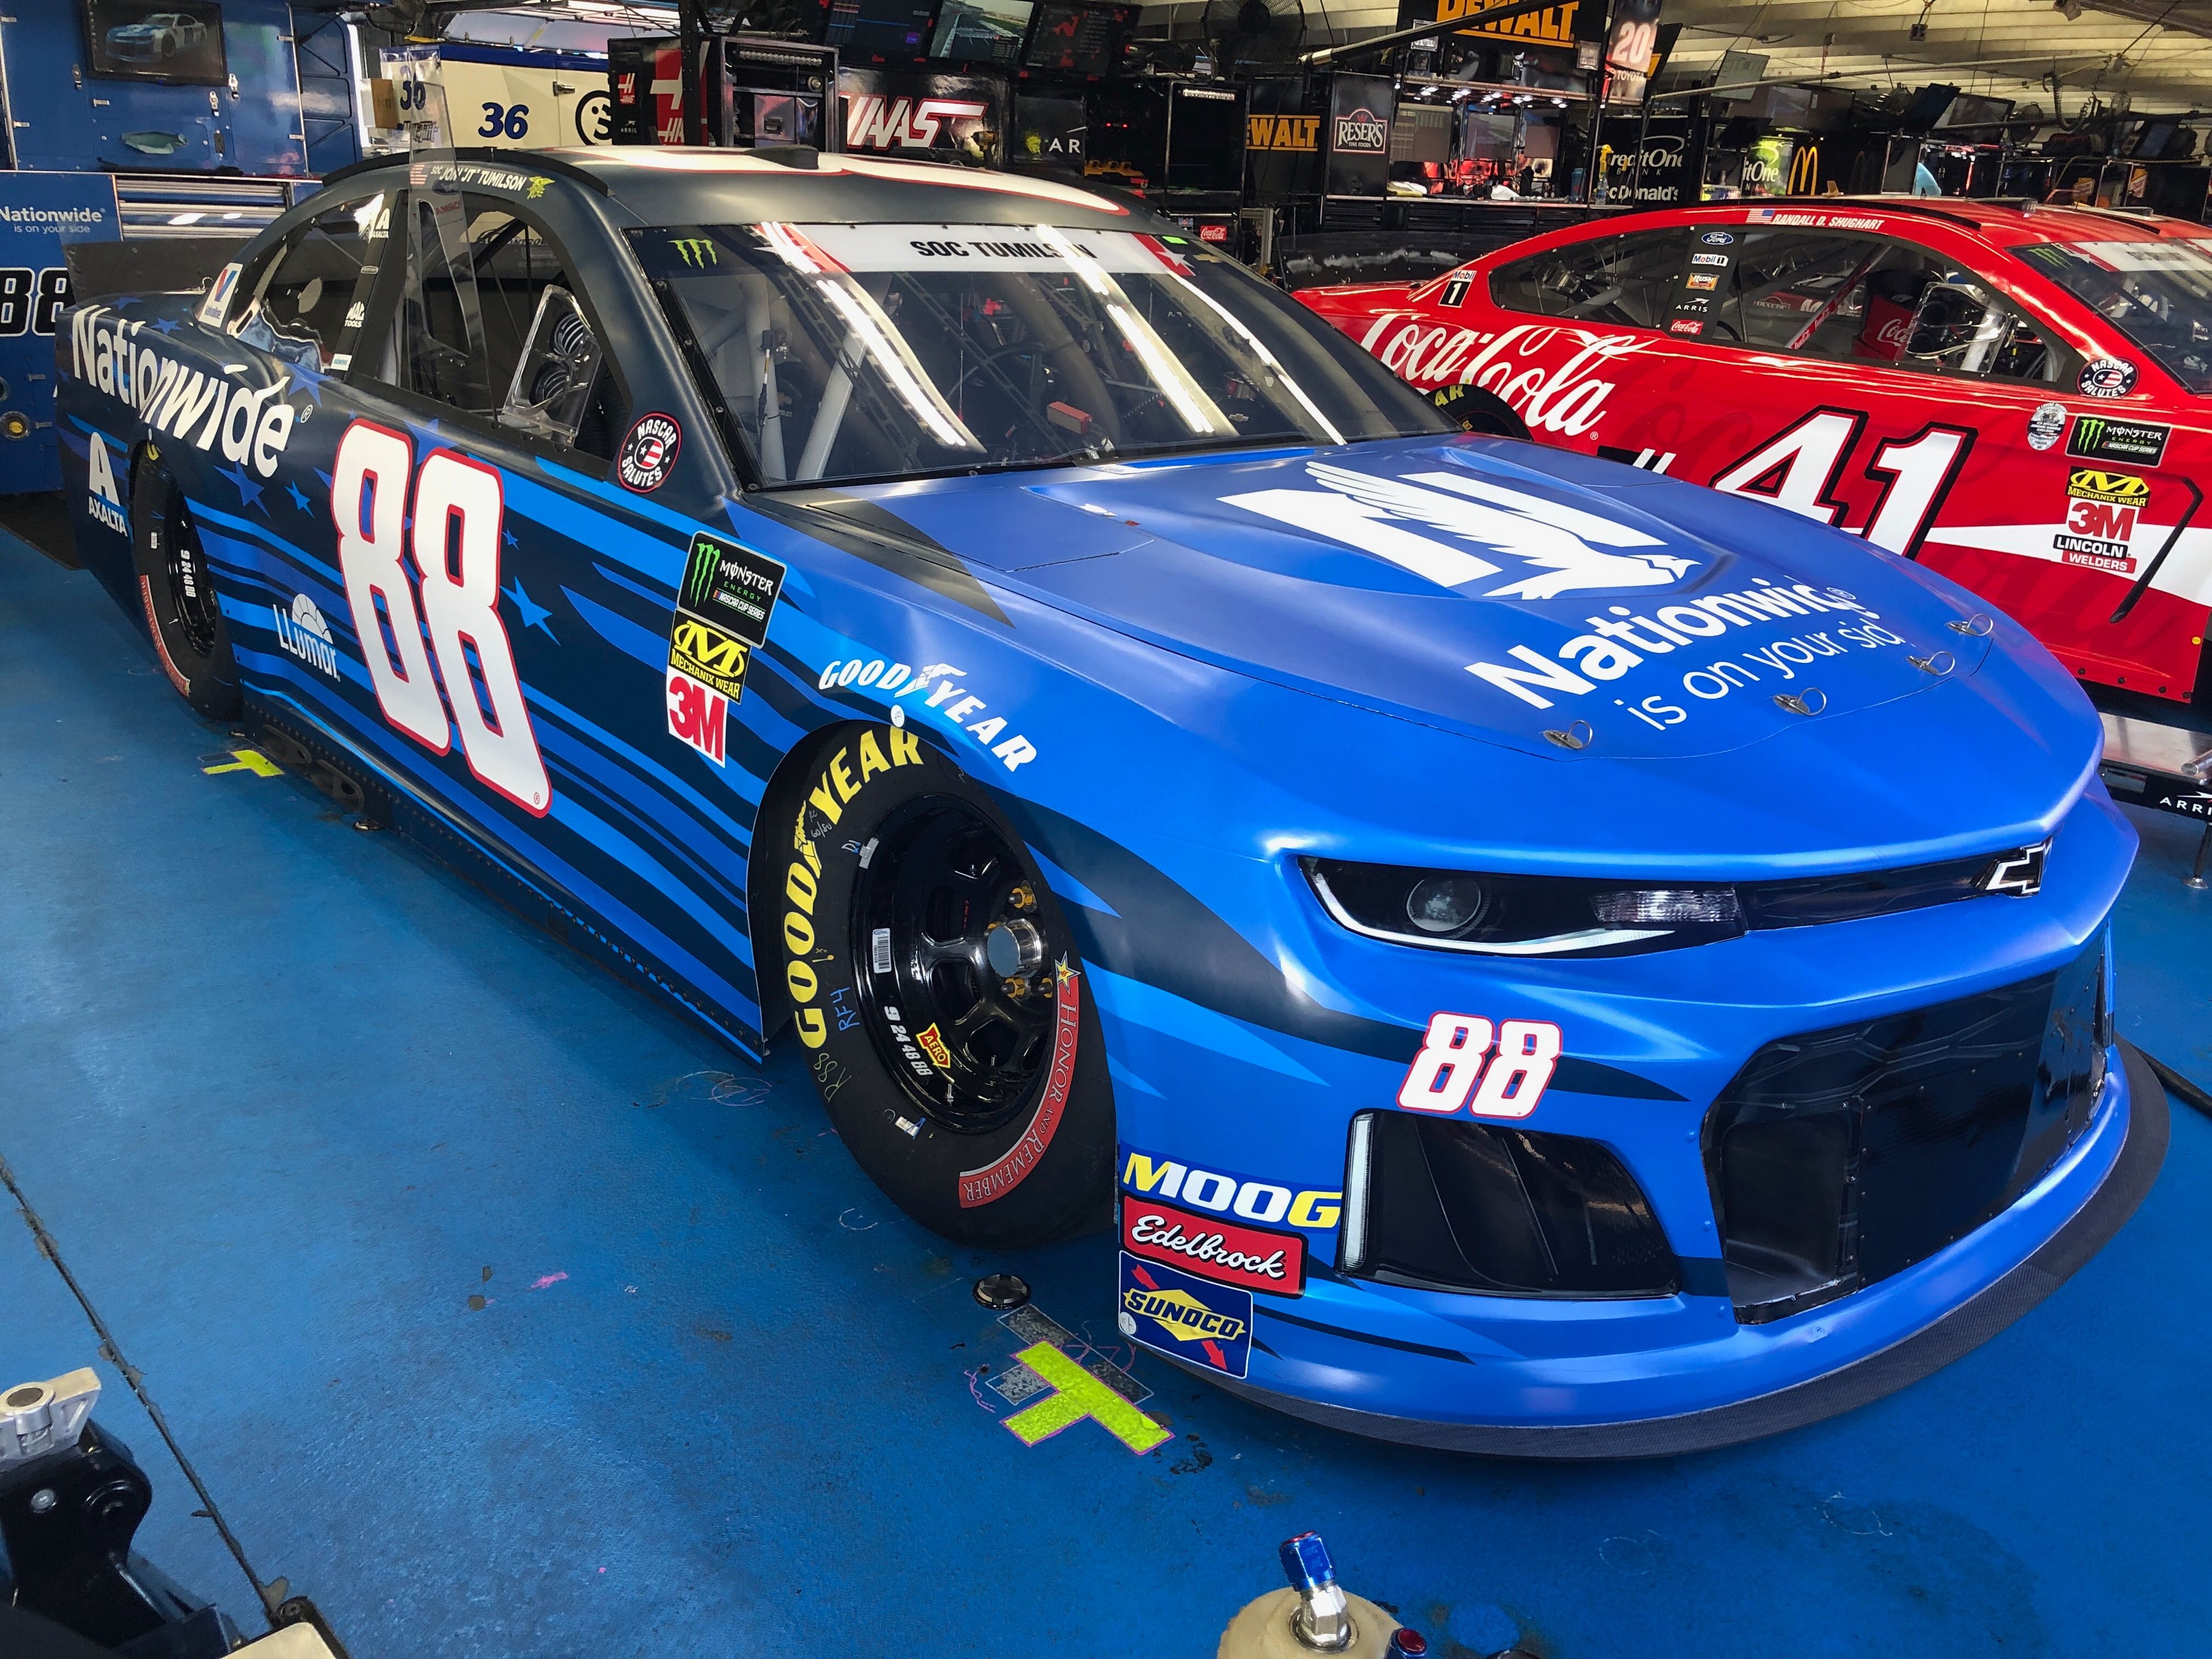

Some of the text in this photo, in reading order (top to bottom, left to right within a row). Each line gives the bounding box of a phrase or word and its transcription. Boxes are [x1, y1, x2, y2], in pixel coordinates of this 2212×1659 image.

[1611, 21, 1651, 64] 20
[1617, 70, 1646, 82] TOYOTA
[479, 102, 529, 139] 36
[1338, 121, 1383, 148] RESER'S
[477, 171, 527, 191] TUMILSON
[1609, 185, 1679, 201] cDonald's
[0, 206, 103, 222] Nationwide
[14, 223, 91, 234] is on your side
[1828, 217, 1885, 230] SHUGHART
[910, 241, 1098, 259] SOC TUMILSN
[1706, 233, 1728, 244] Ford
[1693, 255, 1717, 263] Mobil
[1453, 270, 1476, 281] Mobil
[0, 267, 76, 337] 88
[1447, 281, 1463, 304] 1
[345, 320, 363, 328] TOOLS
[2091, 359, 2134, 377] NASCAR
[72, 304, 295, 478] Nationwide
[2081, 380, 2126, 397] SALUTES
[637, 419, 676, 450] NASCAR
[2106, 426, 2163, 441] MONSTER
[2112, 437, 2152, 445] ENERGY
[2138, 446, 2158, 454] SERIES
[622, 455, 663, 487] SALUTES
[1709, 406, 1977, 561] 41
[2067, 486, 2147, 507] MECHANIX WEAR
[88, 496, 128, 539] AXALTA
[2068, 501, 2137, 542] 3M
[2056, 537, 2125, 558] LINCOLN
[2069, 552, 2129, 572] WELDERS
[180, 549, 196, 598] 9 24 48 88
[719, 560, 774, 596] MONSTER
[724, 580, 762, 602] ENERGY
[331, 418, 552, 818] 88
[719, 592, 766, 620] NASCAR CUP SERIES
[273, 604, 338, 680] LLumar
[670, 648, 741, 700] MECHANIX WEAR
[1614, 618, 1916, 731] is on your sid
[669, 676, 726, 763] 3M
[818, 659, 1039, 772] GOODYEAR
[783, 726, 923, 1048] GOODYEAR
[884, 1006, 934, 1076] 9 24 48 88
[924, 1035, 947, 1063] AERO
[1396, 1011, 1563, 1119] 88
[962, 1002, 1077, 1203] HONOR AND REMEMBER
[1123, 1152, 1343, 1229] MOOG
[1131, 1214, 1287, 1280] Edelbrock
[1127, 1291, 1243, 1340] SUNOCO
